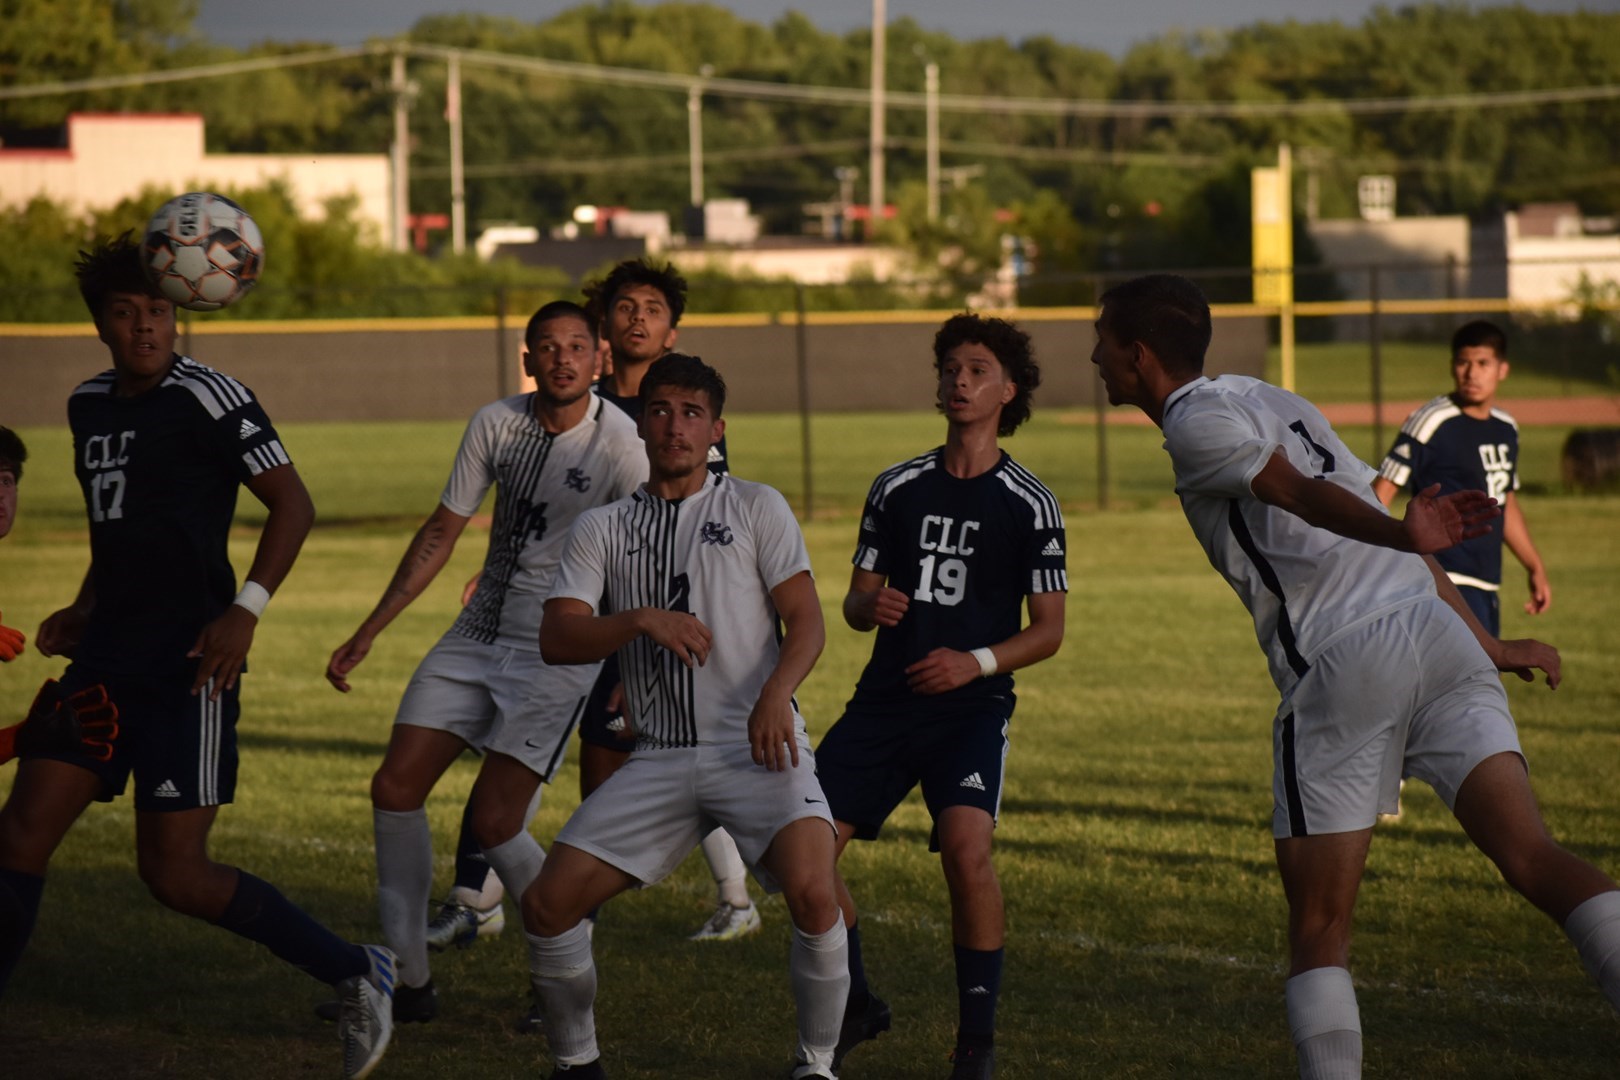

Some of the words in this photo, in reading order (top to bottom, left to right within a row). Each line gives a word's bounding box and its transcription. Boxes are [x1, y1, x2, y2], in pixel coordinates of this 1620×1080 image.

[84, 430, 136, 469] CLC
[90, 469, 126, 522] 17
[919, 514, 980, 556] CLC
[913, 554, 968, 607] 19
